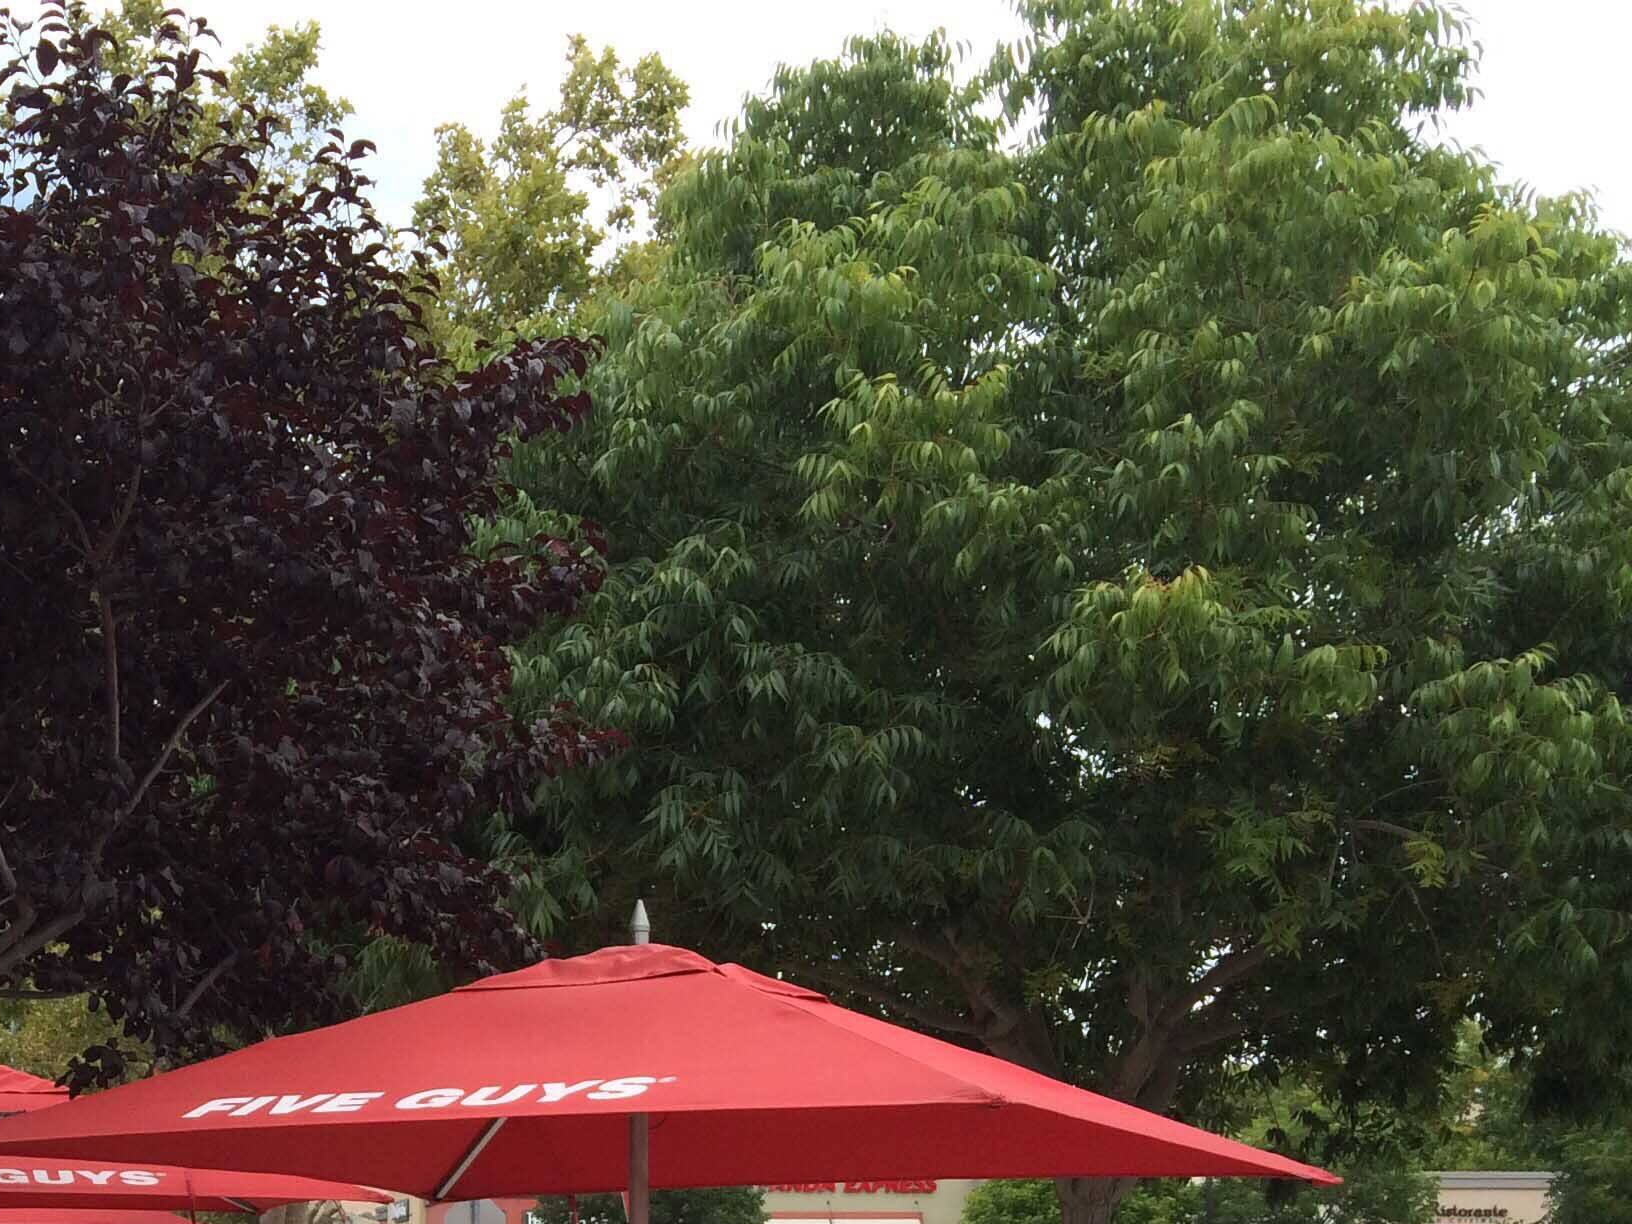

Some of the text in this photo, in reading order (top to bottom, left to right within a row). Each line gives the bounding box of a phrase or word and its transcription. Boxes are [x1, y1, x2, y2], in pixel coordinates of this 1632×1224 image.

[181, 1076, 660, 1119] FIVE GUYS
[1432, 1201, 1508, 1217] Ristorante
